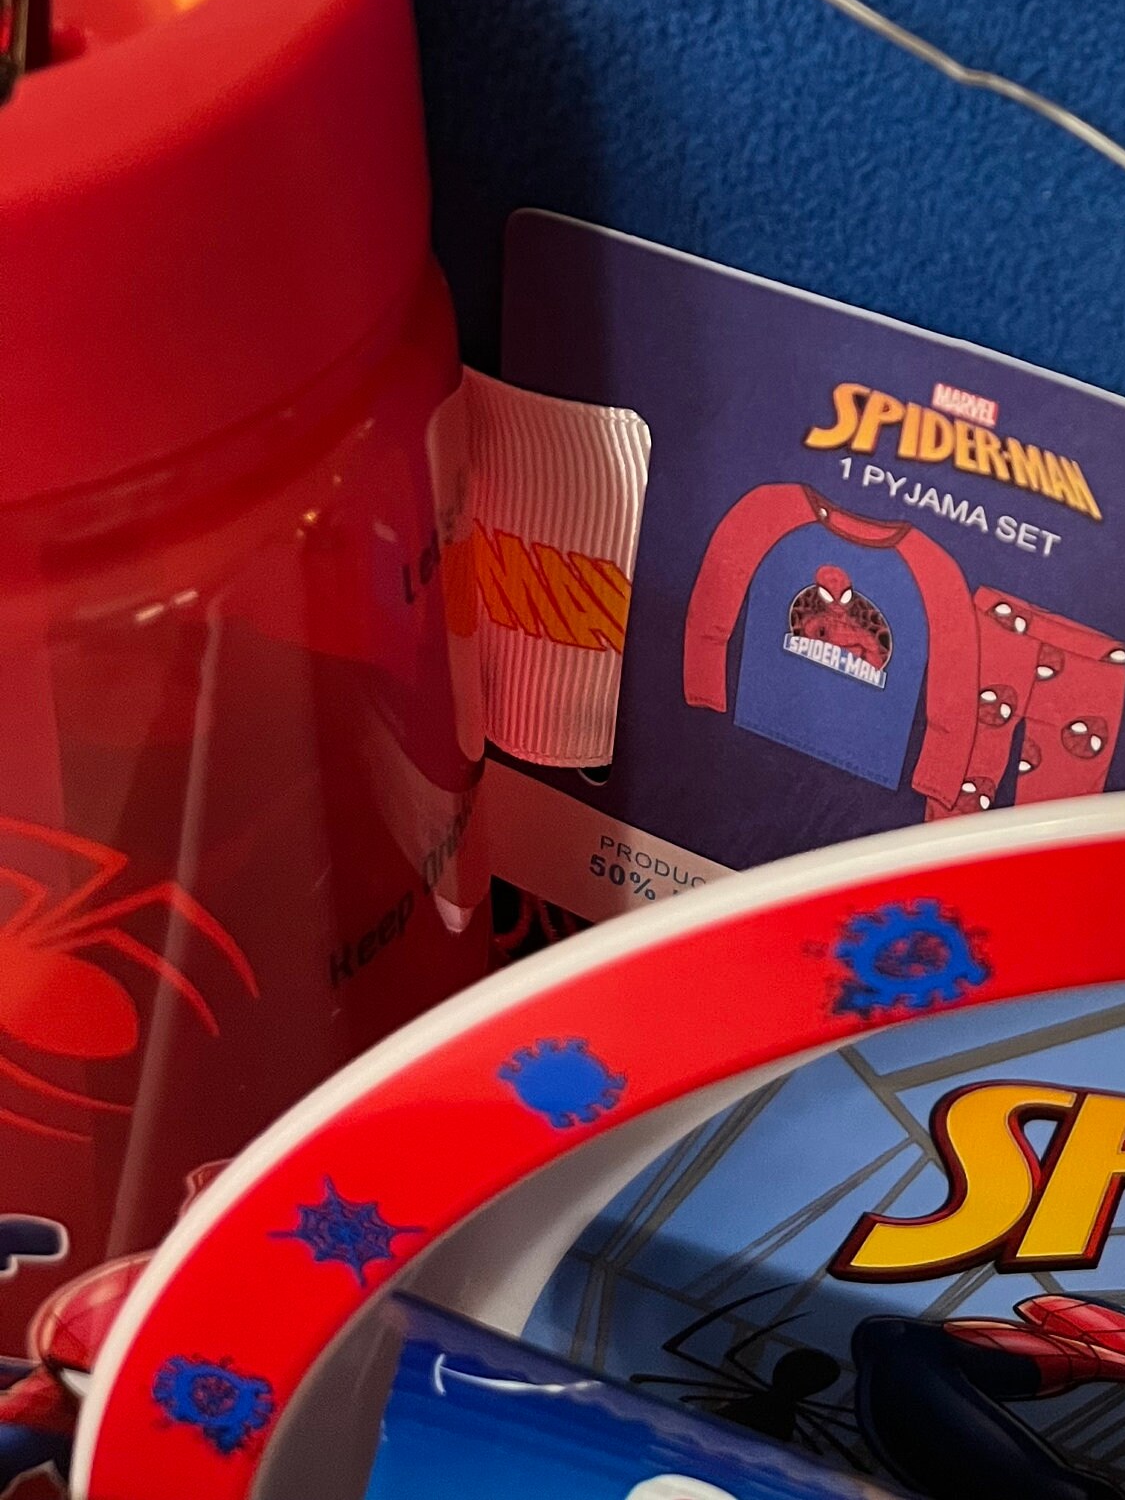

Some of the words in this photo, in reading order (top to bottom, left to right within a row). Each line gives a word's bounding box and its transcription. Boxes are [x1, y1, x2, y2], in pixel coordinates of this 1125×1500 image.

[934, 384, 998, 426] MARVEL
[804, 382, 1102, 521] SPIDER-MAN
[840, 457, 852, 480] 1
[862, 464, 989, 533] PYJAMA
[995, 514, 1062, 557] SET
[788, 636, 882, 685] SPIDER-MAN
[589, 854, 657, 900] 50%
